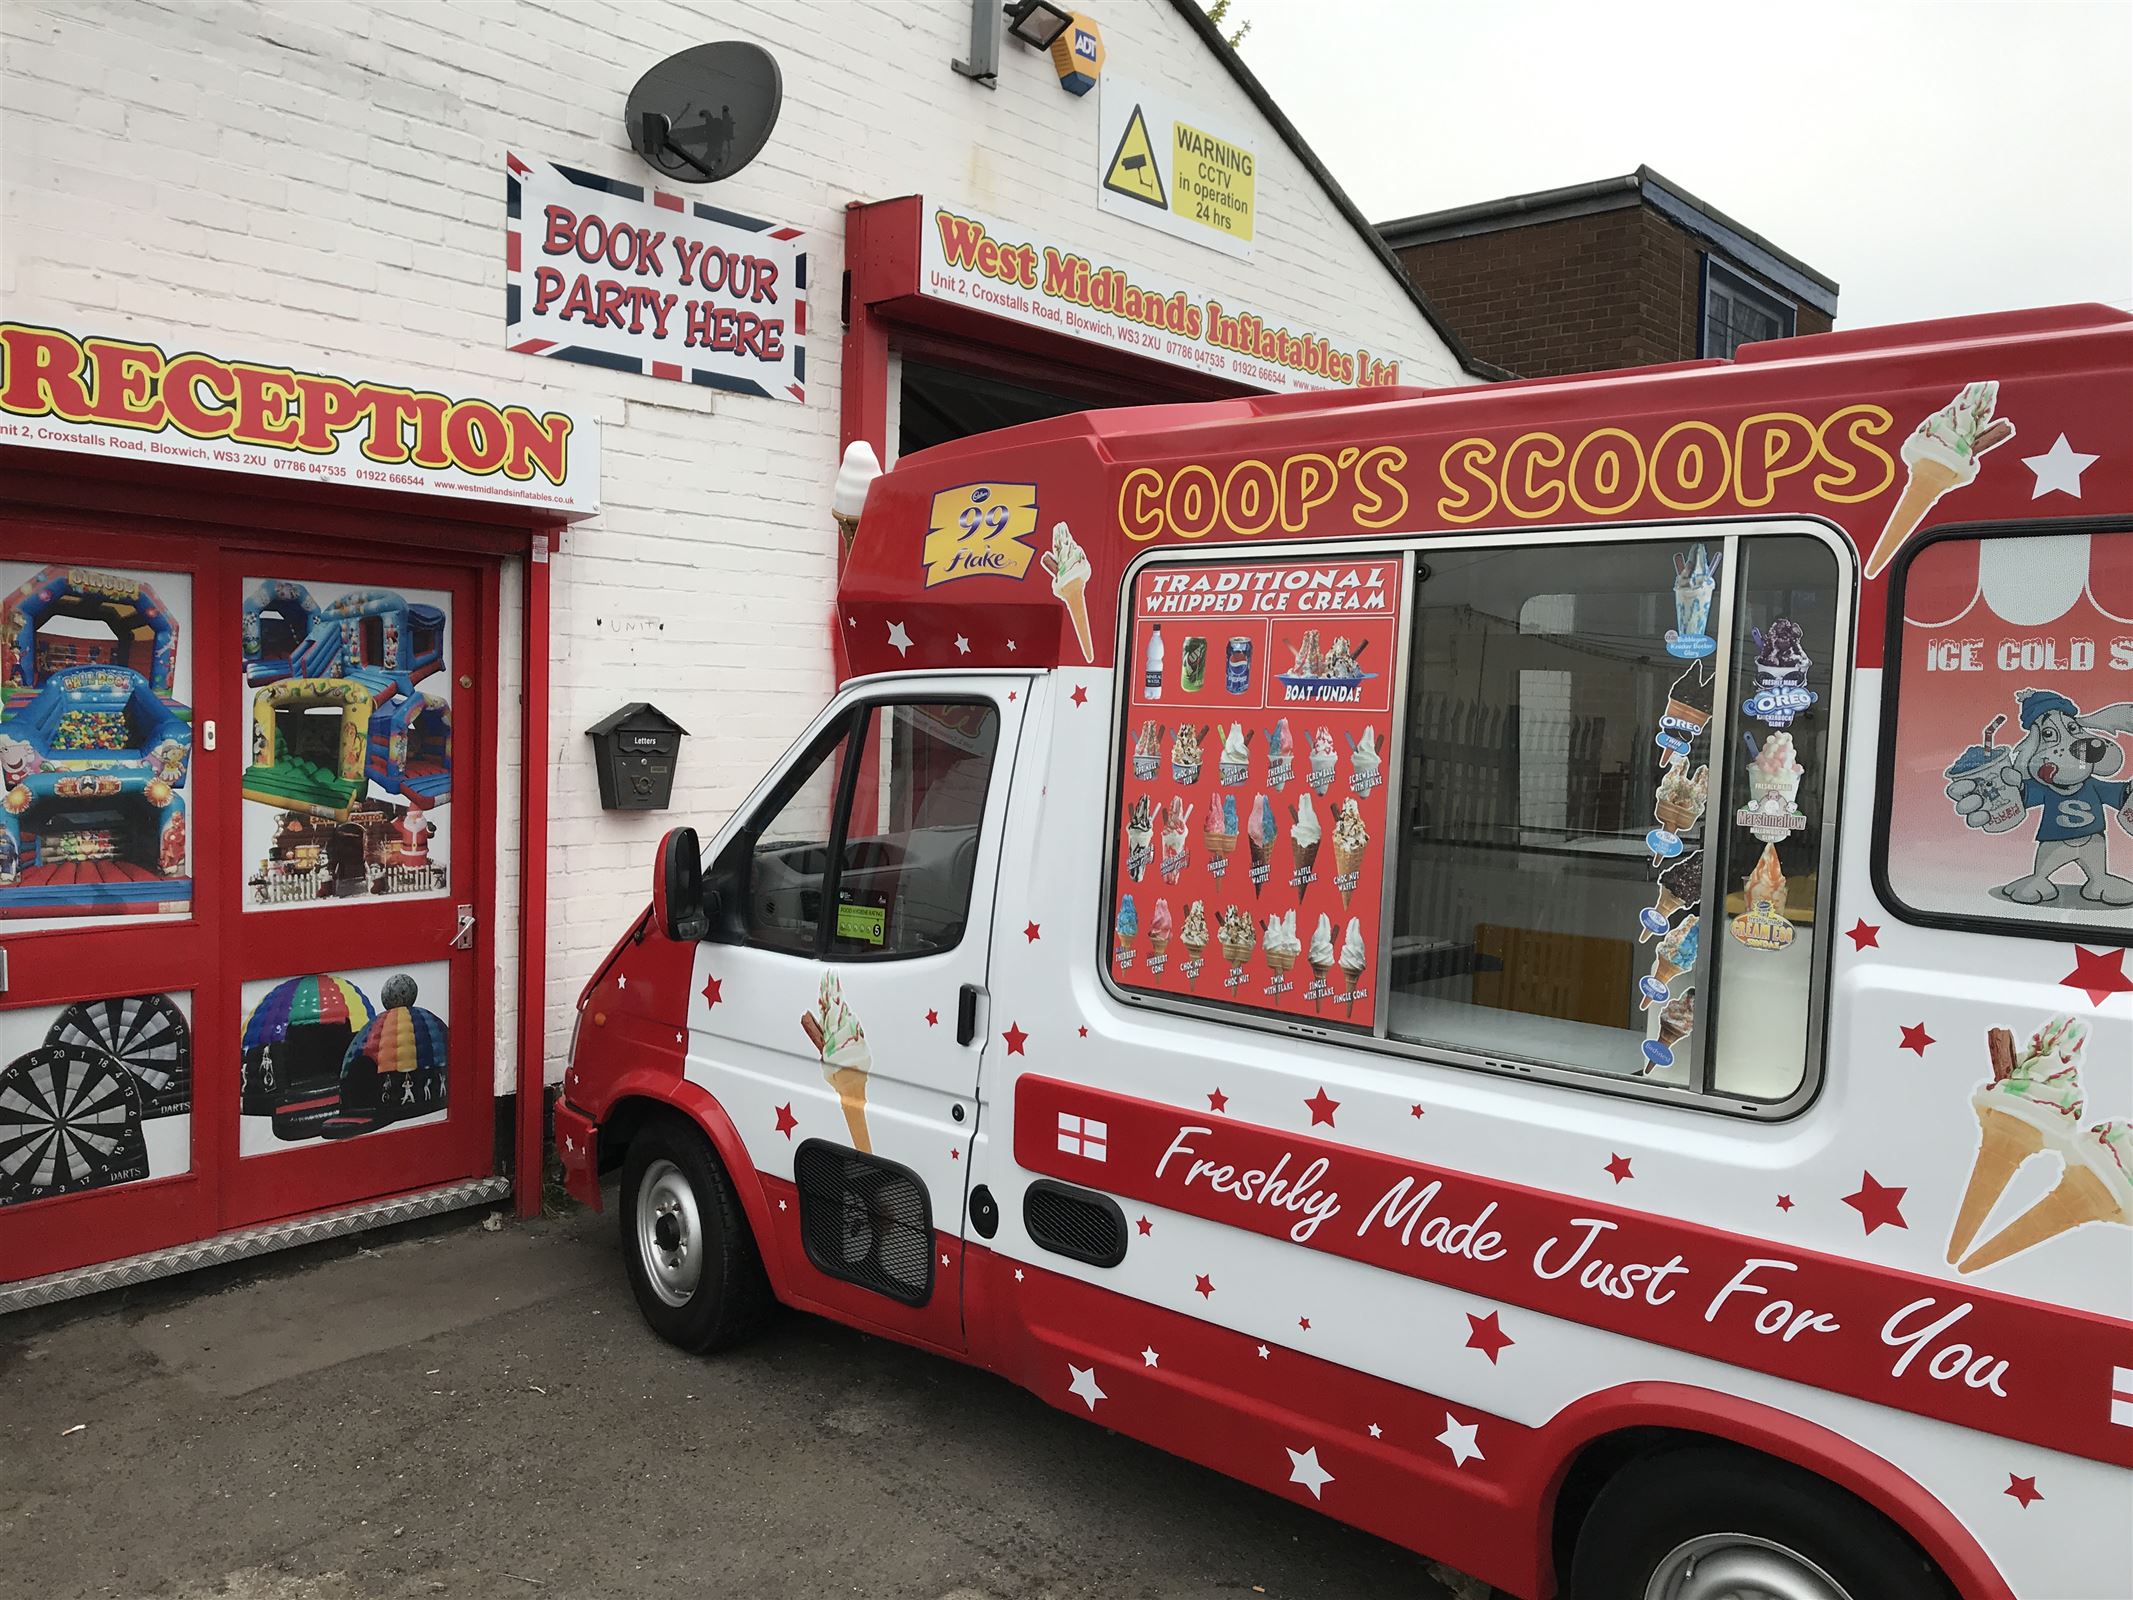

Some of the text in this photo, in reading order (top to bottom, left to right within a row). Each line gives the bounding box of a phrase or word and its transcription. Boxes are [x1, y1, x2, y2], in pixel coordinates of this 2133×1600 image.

[1075, 35, 1096, 58] ADT
[1177, 125, 1252, 176] WARNING
[1198, 162, 1232, 189] CCTV
[1179, 172, 1248, 214] in operation
[1196, 202, 1231, 230] 24 hrs
[542, 204, 778, 305] BOOK YOUR
[935, 210, 1399, 388] West Midlands Inflatables Ltd
[533, 266, 784, 362] PARTY HERE
[930, 270, 1286, 385] Unit 2, Croxstalls Road, Bloxwich, WS3 2XU 07786 047535 01922 666544
[0, 322, 573, 486] RECEPTION
[0, 424, 575, 505] nit 2, Croxstalls Road, Bloxwich, WS3 2XU 07786 047535 01922 666544 www.westmidlandsinflatables.co.uk
[1119, 404, 1895, 541] COOP'S SCOOPS
[957, 505, 1010, 542] 99
[944, 546, 1013, 571] Flake
[1152, 568, 1387, 593] TRADITIONAL
[1146, 590, 1386, 613] WHIPPED ICE CREAM
[611, 619, 656, 633] UNIT
[1926, 637, 1984, 672] ICE
[1997, 636, 2095, 672] COLD
[1284, 684, 1361, 702] BOAT SUNDAE
[1757, 694, 1811, 711] OREO
[1662, 716, 1701, 732] OREO
[634, 737, 656, 746] Letters
[1183, 776, 1192, 786] TUB
[1234, 771, 1248, 783] FLAKE
[1738, 811, 1805, 829] Marshmallow
[2056, 799, 2096, 828] S
[1349, 871, 1359, 881] NUT
[1194, 958, 1204, 968] NUT
[1239, 974, 1249, 983] NUT
[1278, 982, 1293, 992] FLAKE
[1318, 987, 1334, 998] FLAKE
[1353, 989, 1367, 999] CONE
[67, 1007, 78, 1017] 12
[174, 1025, 184, 1036] 13
[31, 1057, 38, 1066] 5
[53, 1050, 65, 1059] 20
[98, 1057, 109, 1069] 18
[6, 1068, 19, 1080] 12
[115, 1071, 124, 1079] 4
[123, 1086, 134, 1097] 13
[164, 1081, 175, 1091] 15
[161, 1101, 191, 1114] DARTS
[114, 1146, 125, 1156] 15
[80, 1176, 90, 1186] 17
[111, 1167, 141, 1182] DARTS
[31, 1187, 43, 1195] 19
[1155, 1126, 2008, 1398] Freshly Made Just For You
